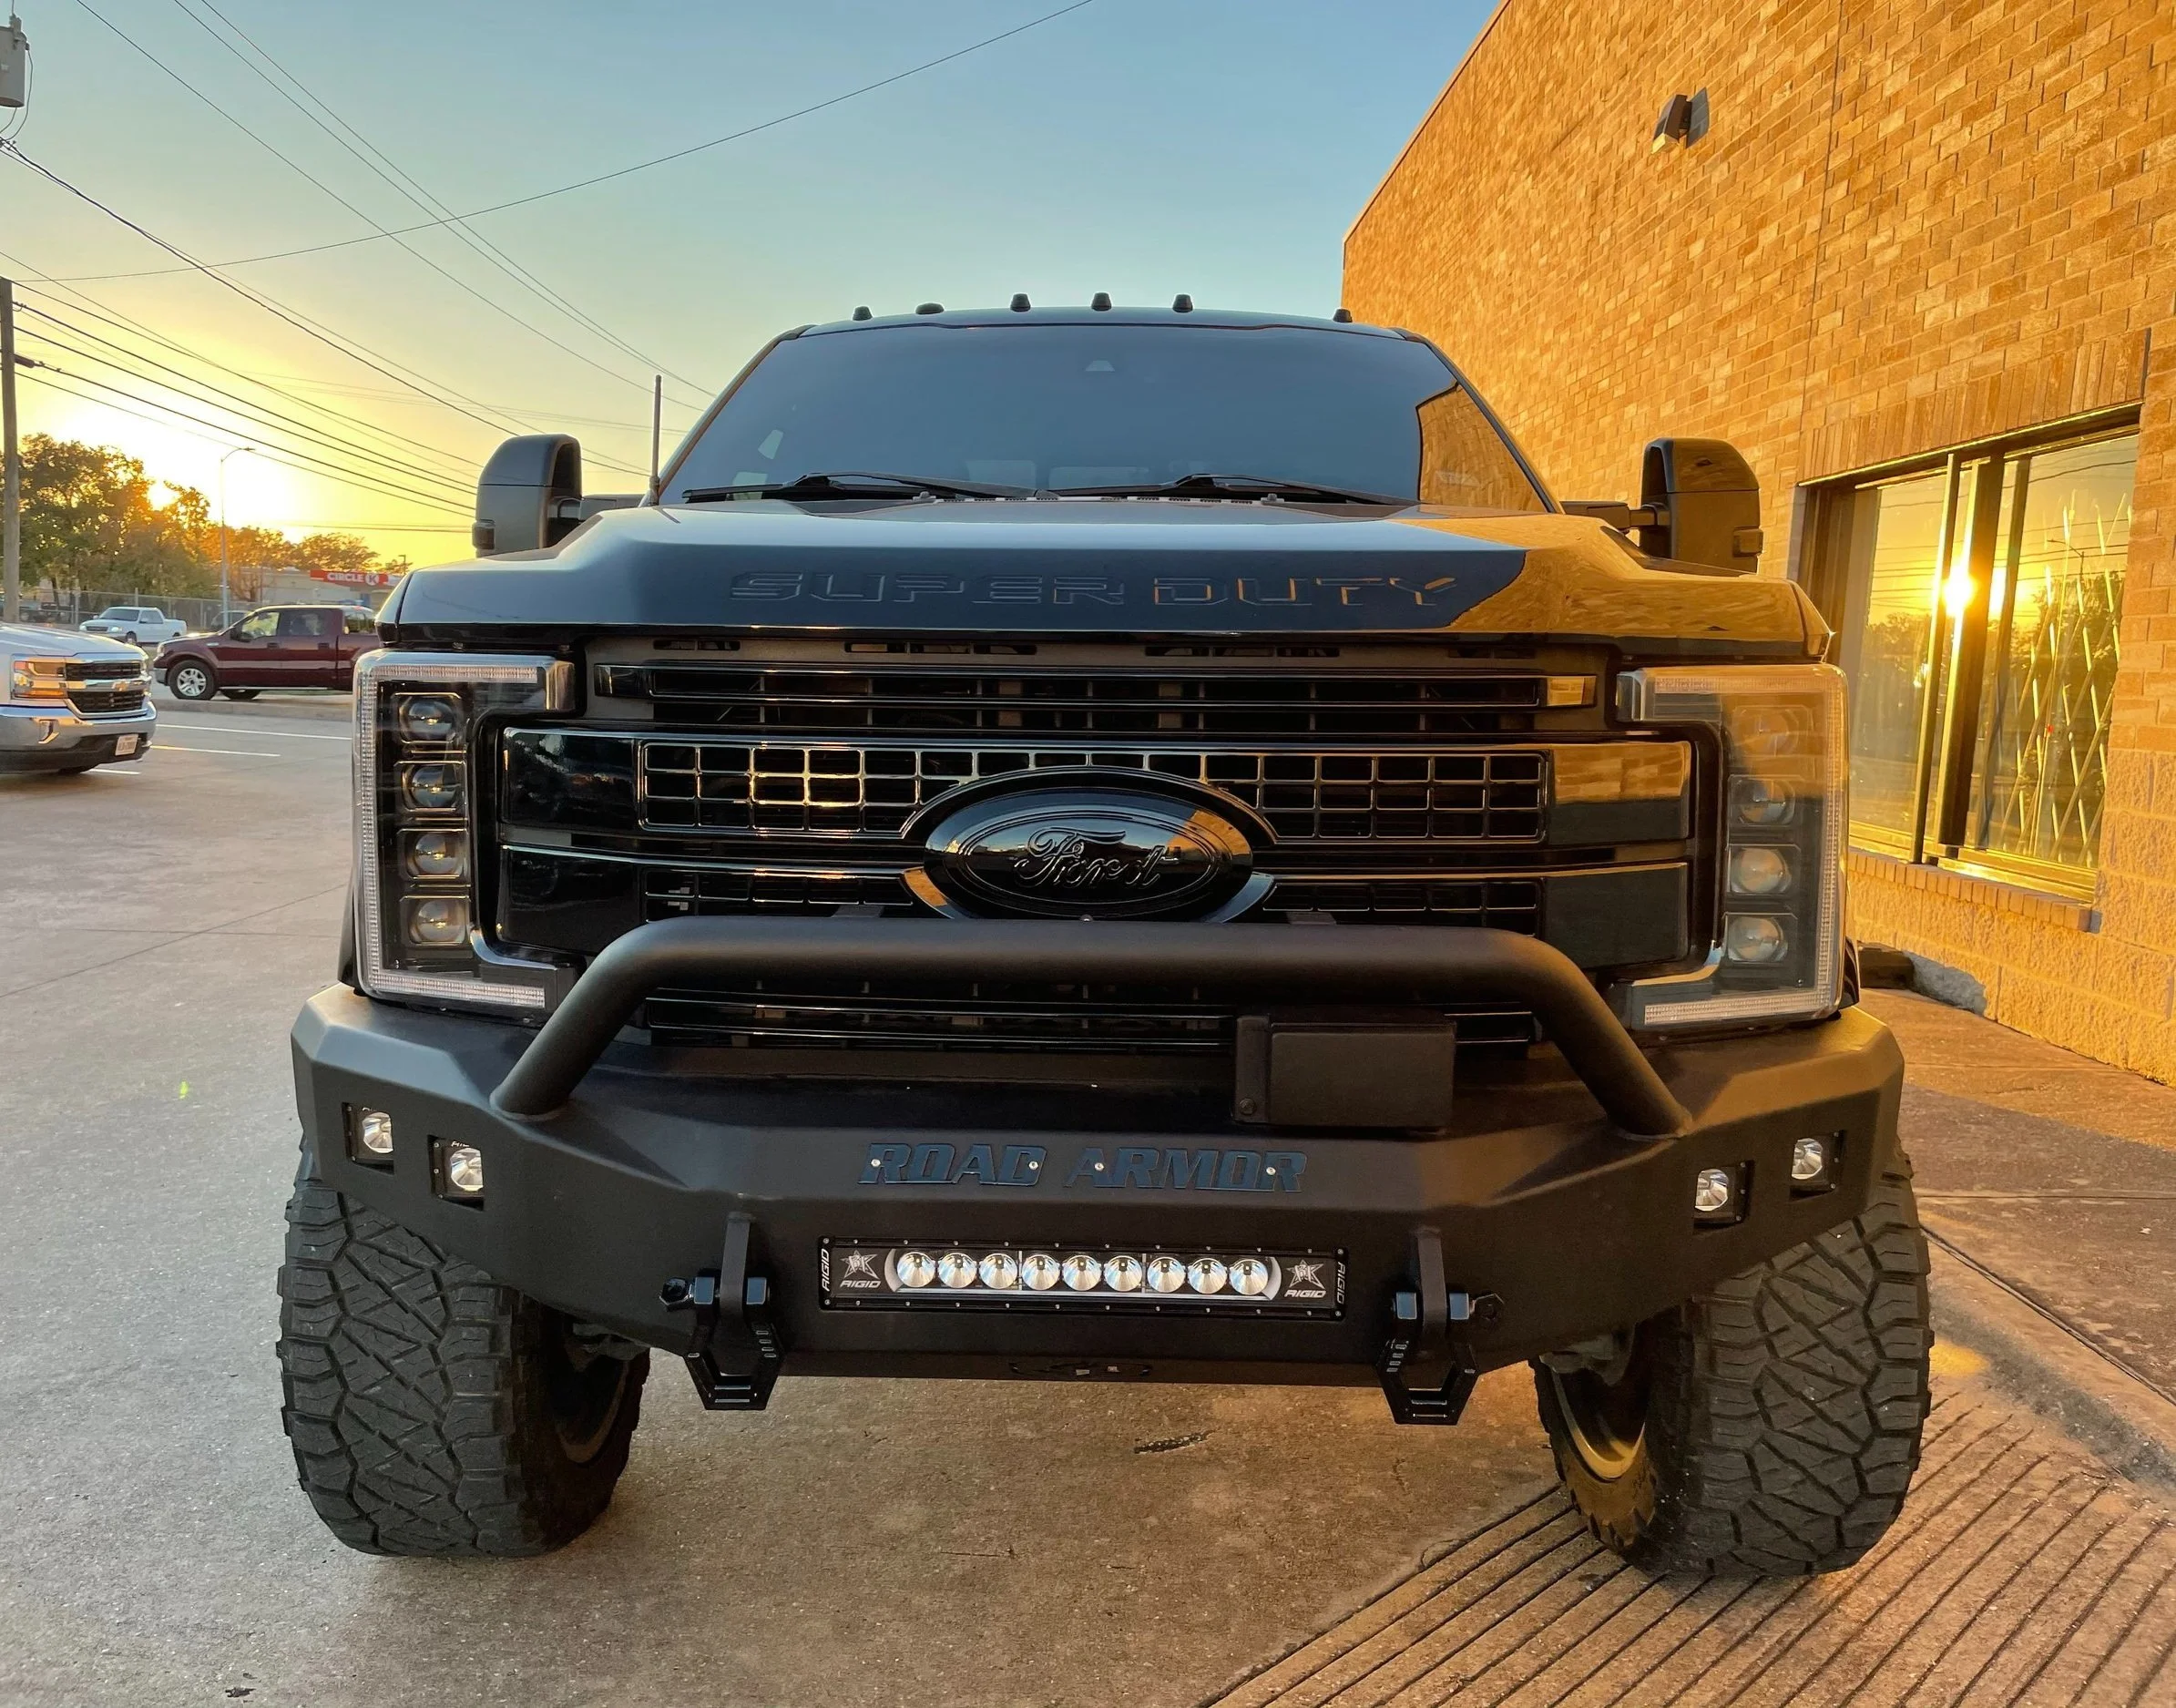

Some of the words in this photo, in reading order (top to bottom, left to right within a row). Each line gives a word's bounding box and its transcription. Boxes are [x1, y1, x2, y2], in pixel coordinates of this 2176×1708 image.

[327, 572, 365, 582] CIRCLE
[730, 572, 1124, 605] SUPER
[1154, 577, 1457, 606] DUTY
[1014, 826, 1170, 888] Ford
[857, 1142, 1047, 1187] ROAD
[1061, 1146, 1308, 1193] ARMOR
[821, 1248, 831, 1292] RIGID
[840, 1280, 882, 1289] RIGID
[1283, 1289, 1326, 1298] RIGID
